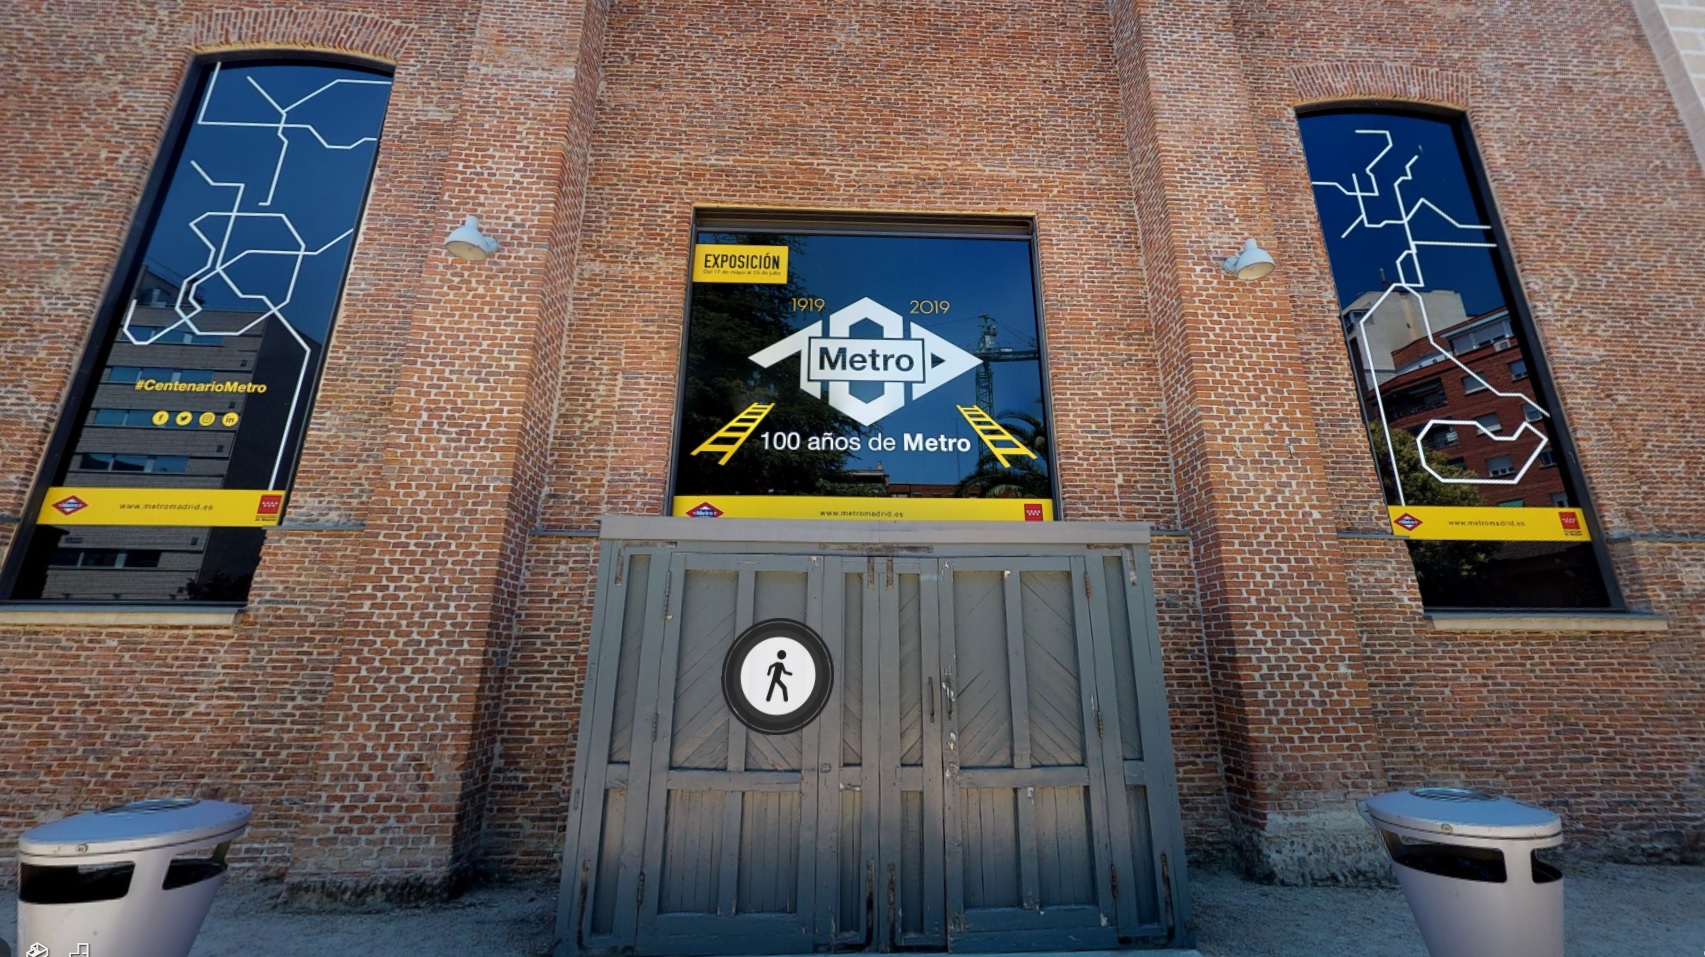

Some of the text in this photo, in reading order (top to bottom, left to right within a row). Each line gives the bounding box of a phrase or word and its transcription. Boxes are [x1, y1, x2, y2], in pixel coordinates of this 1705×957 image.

[704, 252, 780, 270] EXPOSICIÓN
[791, 298, 825, 312] 1919
[909, 300, 950, 315] 2019
[818, 347, 914, 372] Metro
[134, 379, 267, 394] #CentenarioMetro
[760, 432, 971, 452] 100 años de Metro
[119, 503, 214, 511] www.metromadrid.es
[819, 509, 904, 518] www.metromadrid.es
